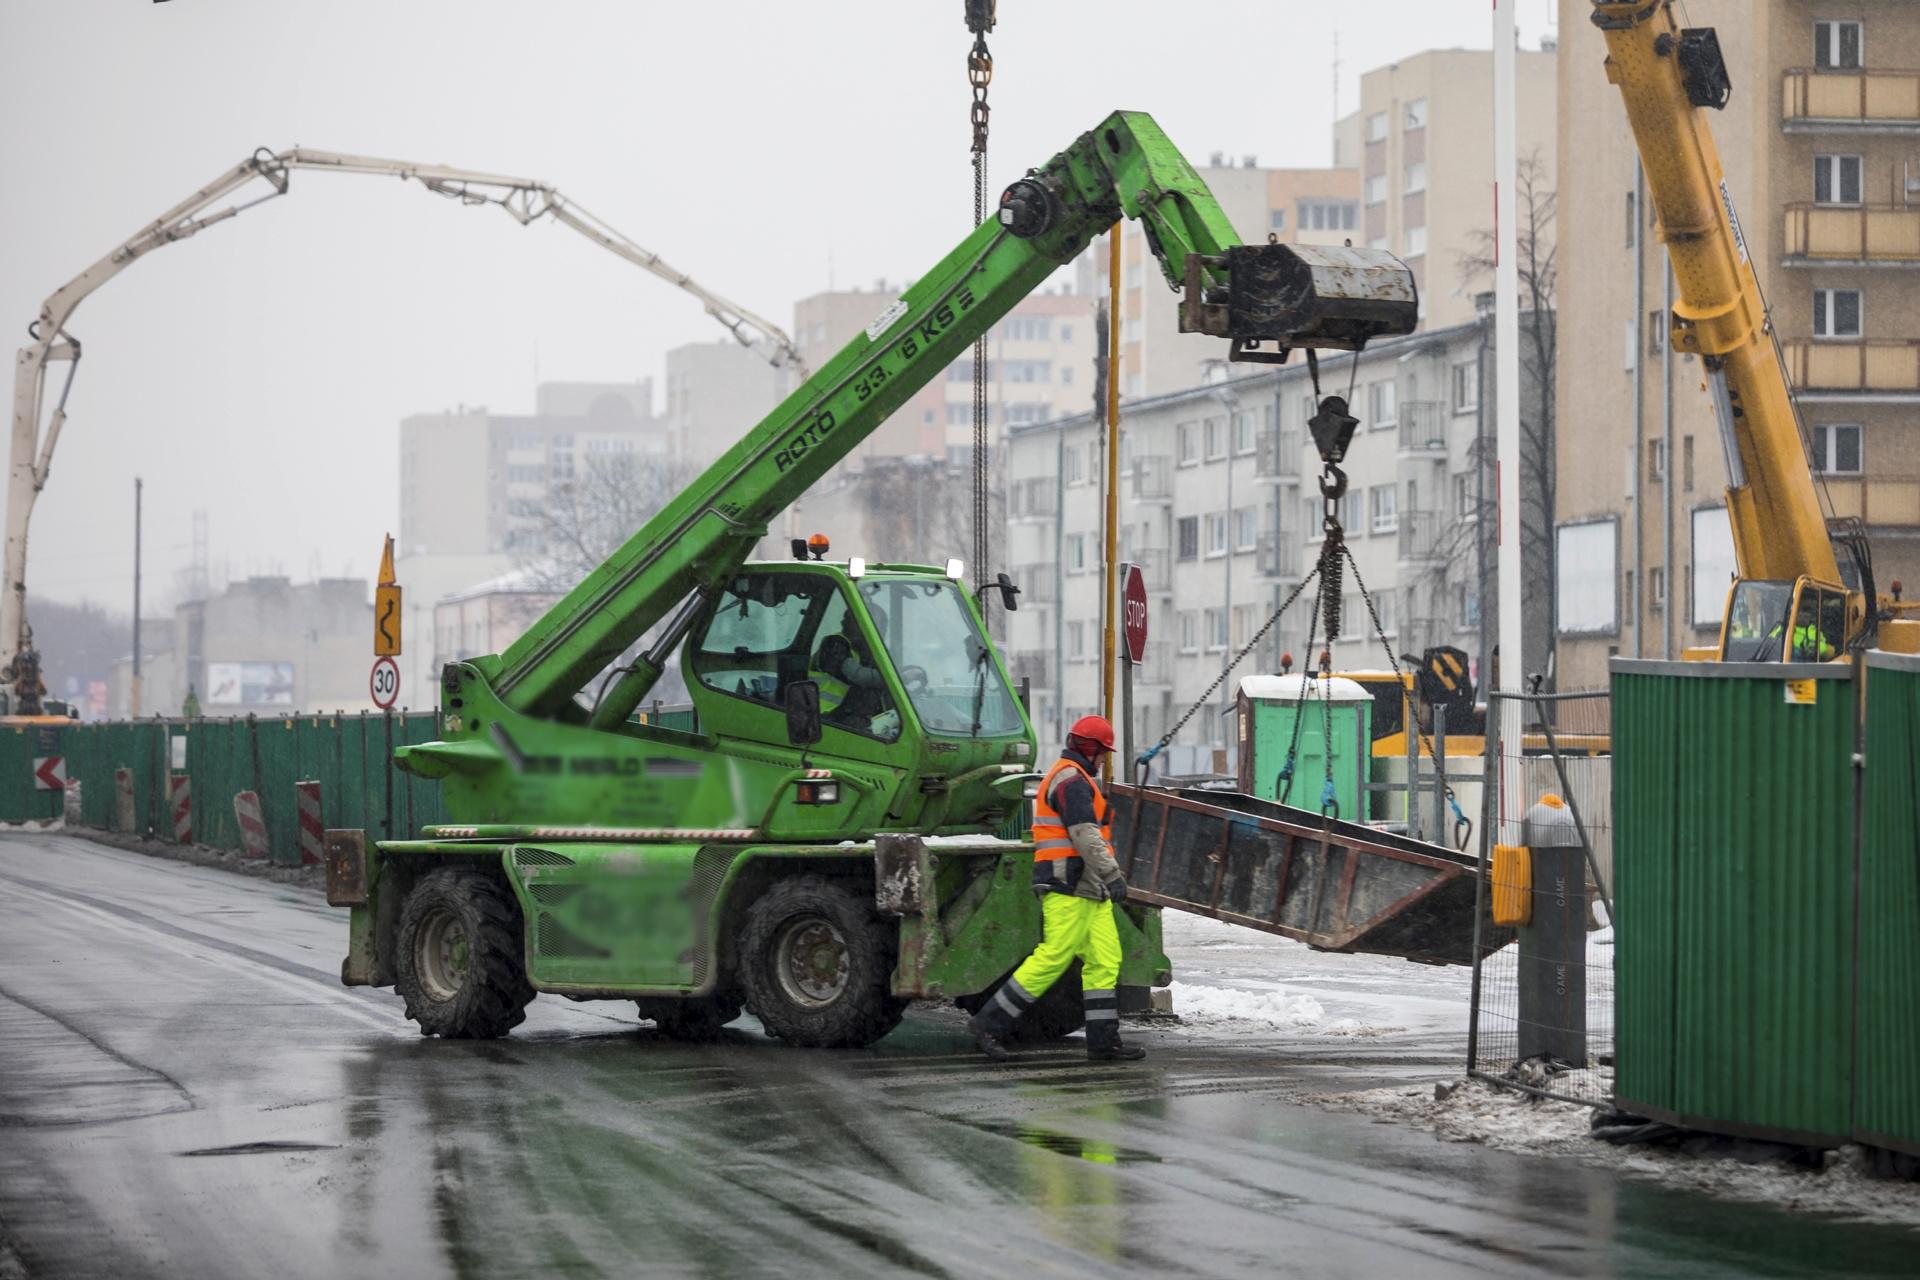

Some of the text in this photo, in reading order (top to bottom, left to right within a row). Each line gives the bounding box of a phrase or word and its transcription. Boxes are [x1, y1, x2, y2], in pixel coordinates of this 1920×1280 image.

[774, 410, 836, 472] ROTO
[920, 304, 955, 344] KS
[1127, 599, 1146, 629] STOP
[375, 669, 394, 694] 30
